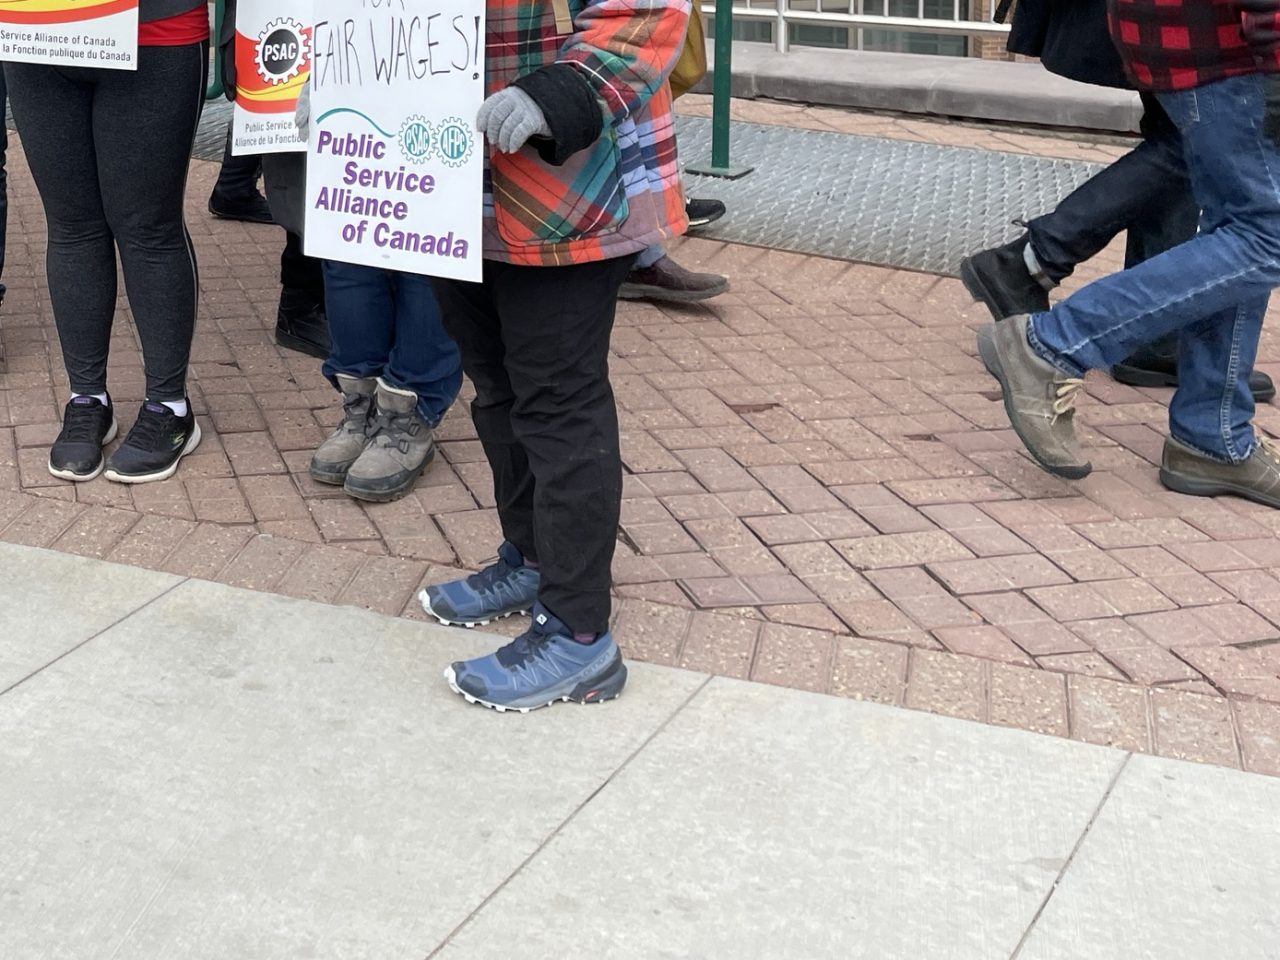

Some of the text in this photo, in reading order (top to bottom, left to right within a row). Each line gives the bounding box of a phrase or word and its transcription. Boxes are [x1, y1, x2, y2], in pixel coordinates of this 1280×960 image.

[0, 30, 32, 41] Service
[34, 32, 69, 44] Alliance
[71, 35, 81, 44] of
[83, 36, 116, 47] Canada
[3, 43, 10, 53] la
[12, 44, 47, 56] Fonction
[49, 47, 85, 59] publique
[87, 49, 97, 59] du
[100, 50, 131, 62] Canada
[263, 42, 297, 62] PSAC
[313, 12, 482, 91] FAIR WAGES!
[234, 136, 257, 147] Alliance
[258, 136, 266, 145] de
[268, 135, 274, 144] la
[245, 123, 264, 133] Public
[265, 120, 292, 131] Service
[406, 124, 429, 155] PSAC
[317, 130, 386, 160] Public
[442, 127, 465, 157] AFPC
[343, 161, 435, 194] Service
[315, 186, 409, 220] Alliance
[342, 220, 469, 260] of Canada
